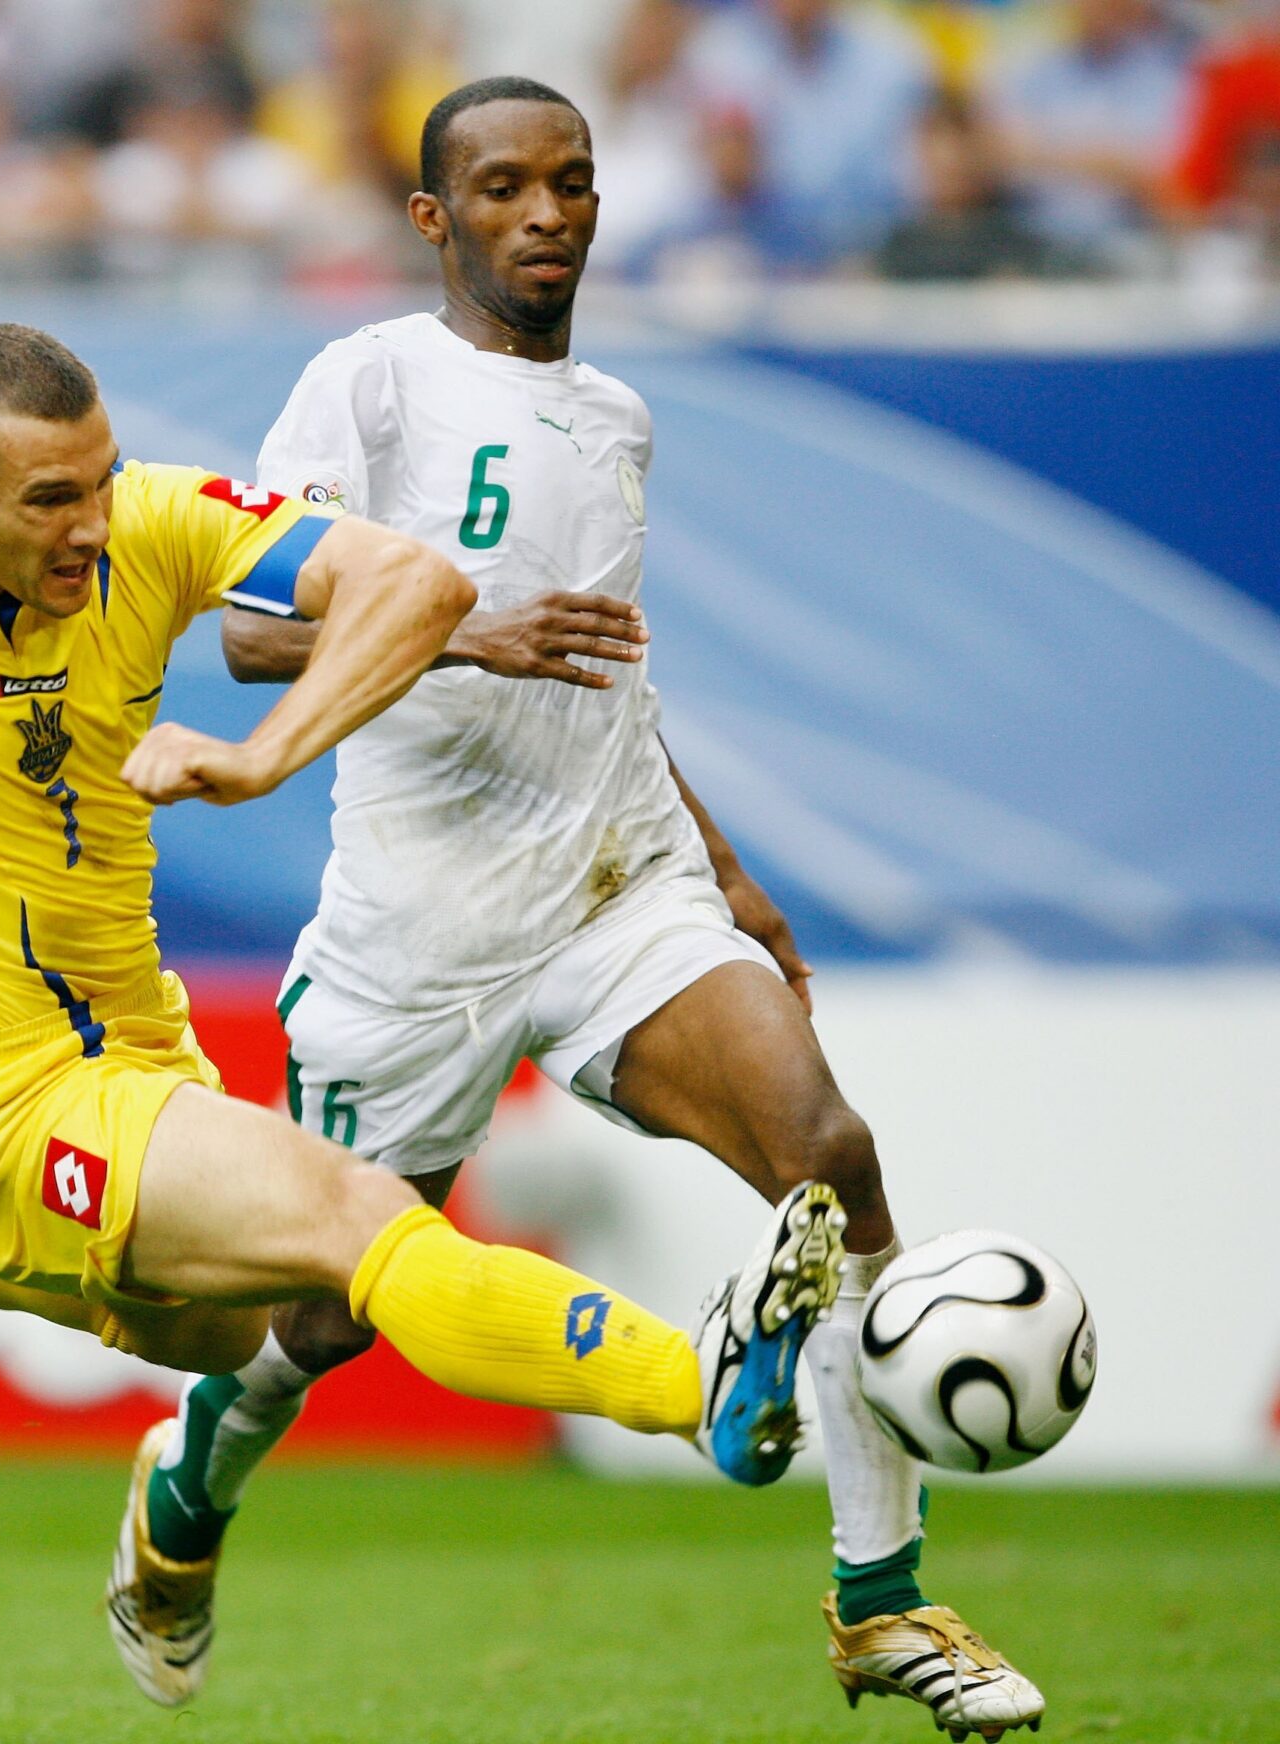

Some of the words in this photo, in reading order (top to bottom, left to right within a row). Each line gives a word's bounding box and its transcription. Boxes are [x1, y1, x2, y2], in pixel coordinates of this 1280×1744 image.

[459, 444, 510, 550] 6
[4, 676, 67, 693] lotto
[322, 1079, 362, 1149] 6
